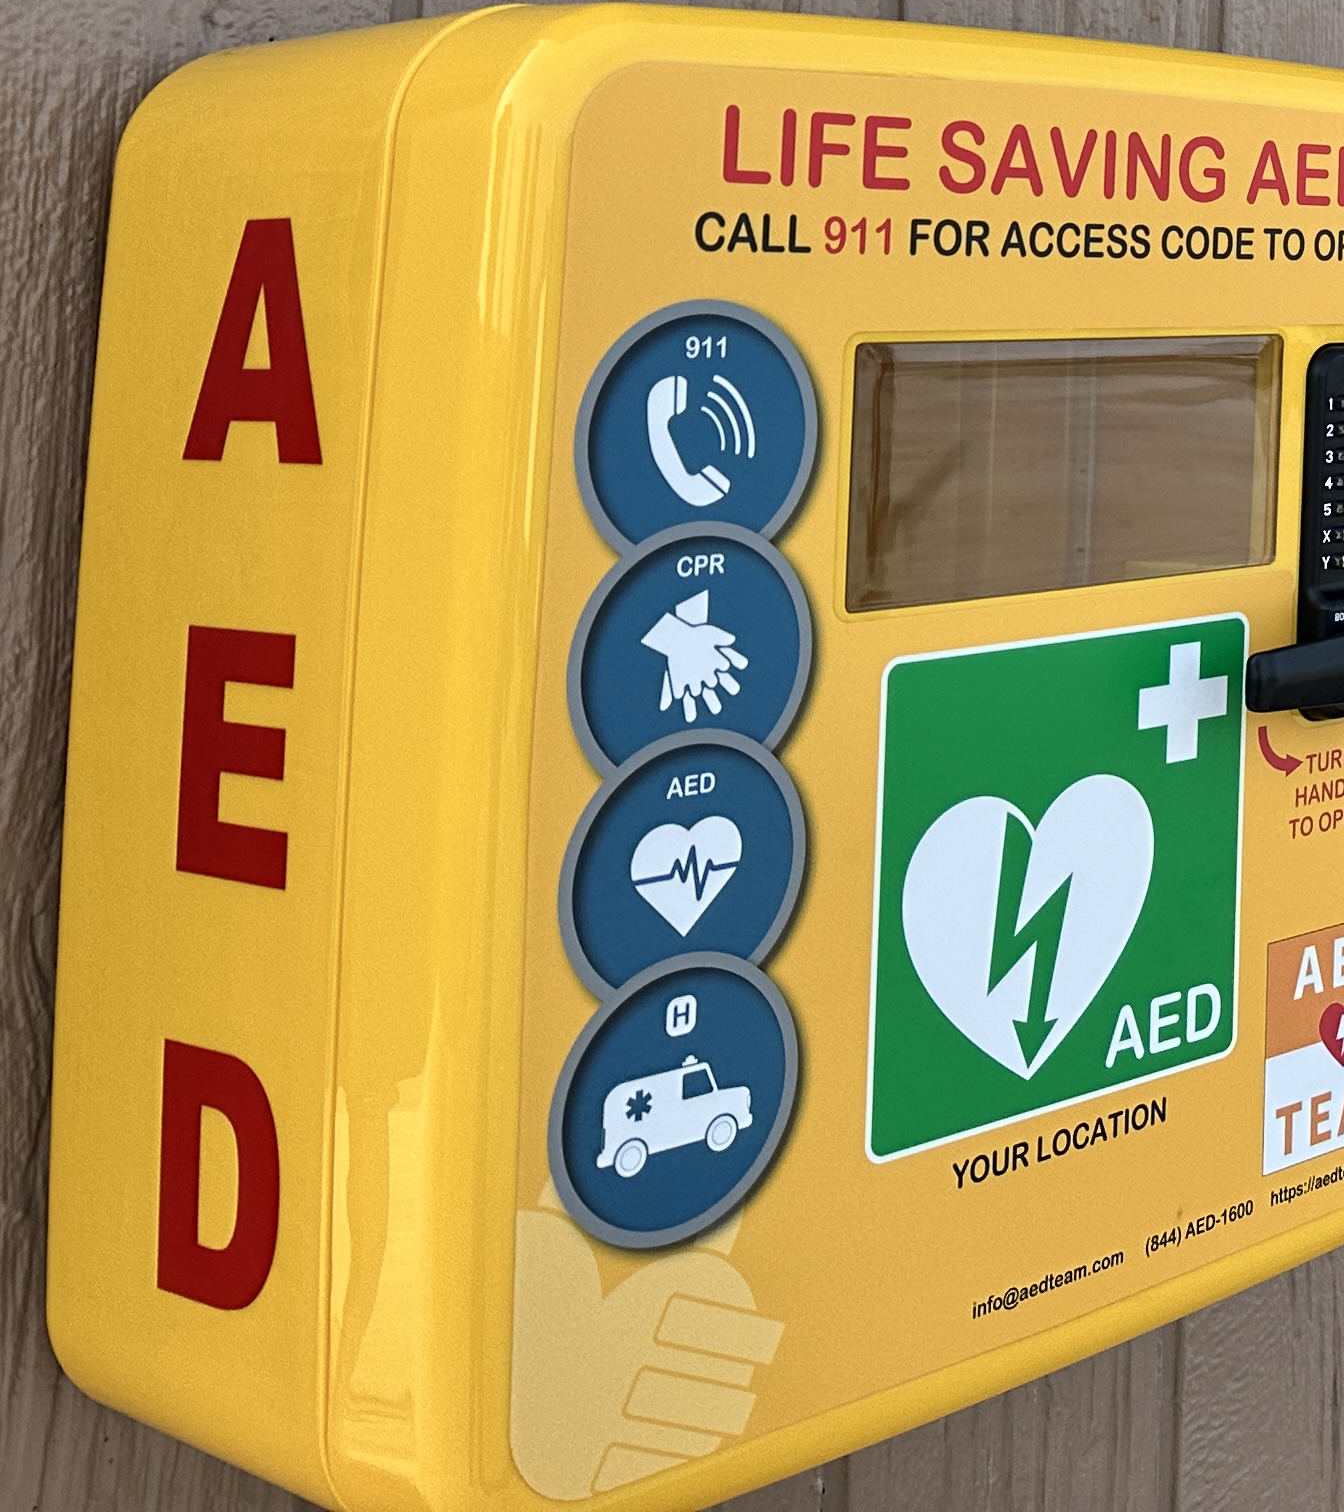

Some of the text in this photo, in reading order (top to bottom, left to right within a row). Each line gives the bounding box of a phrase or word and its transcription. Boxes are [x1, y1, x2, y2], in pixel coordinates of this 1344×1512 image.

[722, 104, 912, 190] LIFE
[938, 119, 1228, 204] SAVING
[694, 211, 812, 255] CALL
[824, 215, 894, 256] 911
[909, 219, 991, 258] FOR
[1000, 222, 1150, 261] ACCESS
[1160, 226, 1255, 262] CODE
[1264, 227, 1305, 262] TO
[684, 336, 729, 361] 911
[1328, 397, 1334, 411] 1
[1326, 424, 1334, 437] 2
[1325, 450, 1334, 463] 3
[1324, 476, 1333, 490] 4
[1323, 503, 1332, 516] 5
[1322, 529, 1331, 543] X
[676, 554, 726, 579] CPR
[1322, 556, 1331, 570] Y
[157, 217, 322, 1311] AED
[666, 772, 717, 800] AED
[1288, 816, 1314, 839] TO
[672, 1004, 691, 1028] H
[1104, 982, 1222, 1070] AED
[952, 1097, 1169, 1191] YOUR LOCATION
[972, 1250, 1125, 1320] info@aedteam.com
[1144, 1225, 1182, 1258] (844)
[1184, 1199, 1254, 1240] AED-1600
